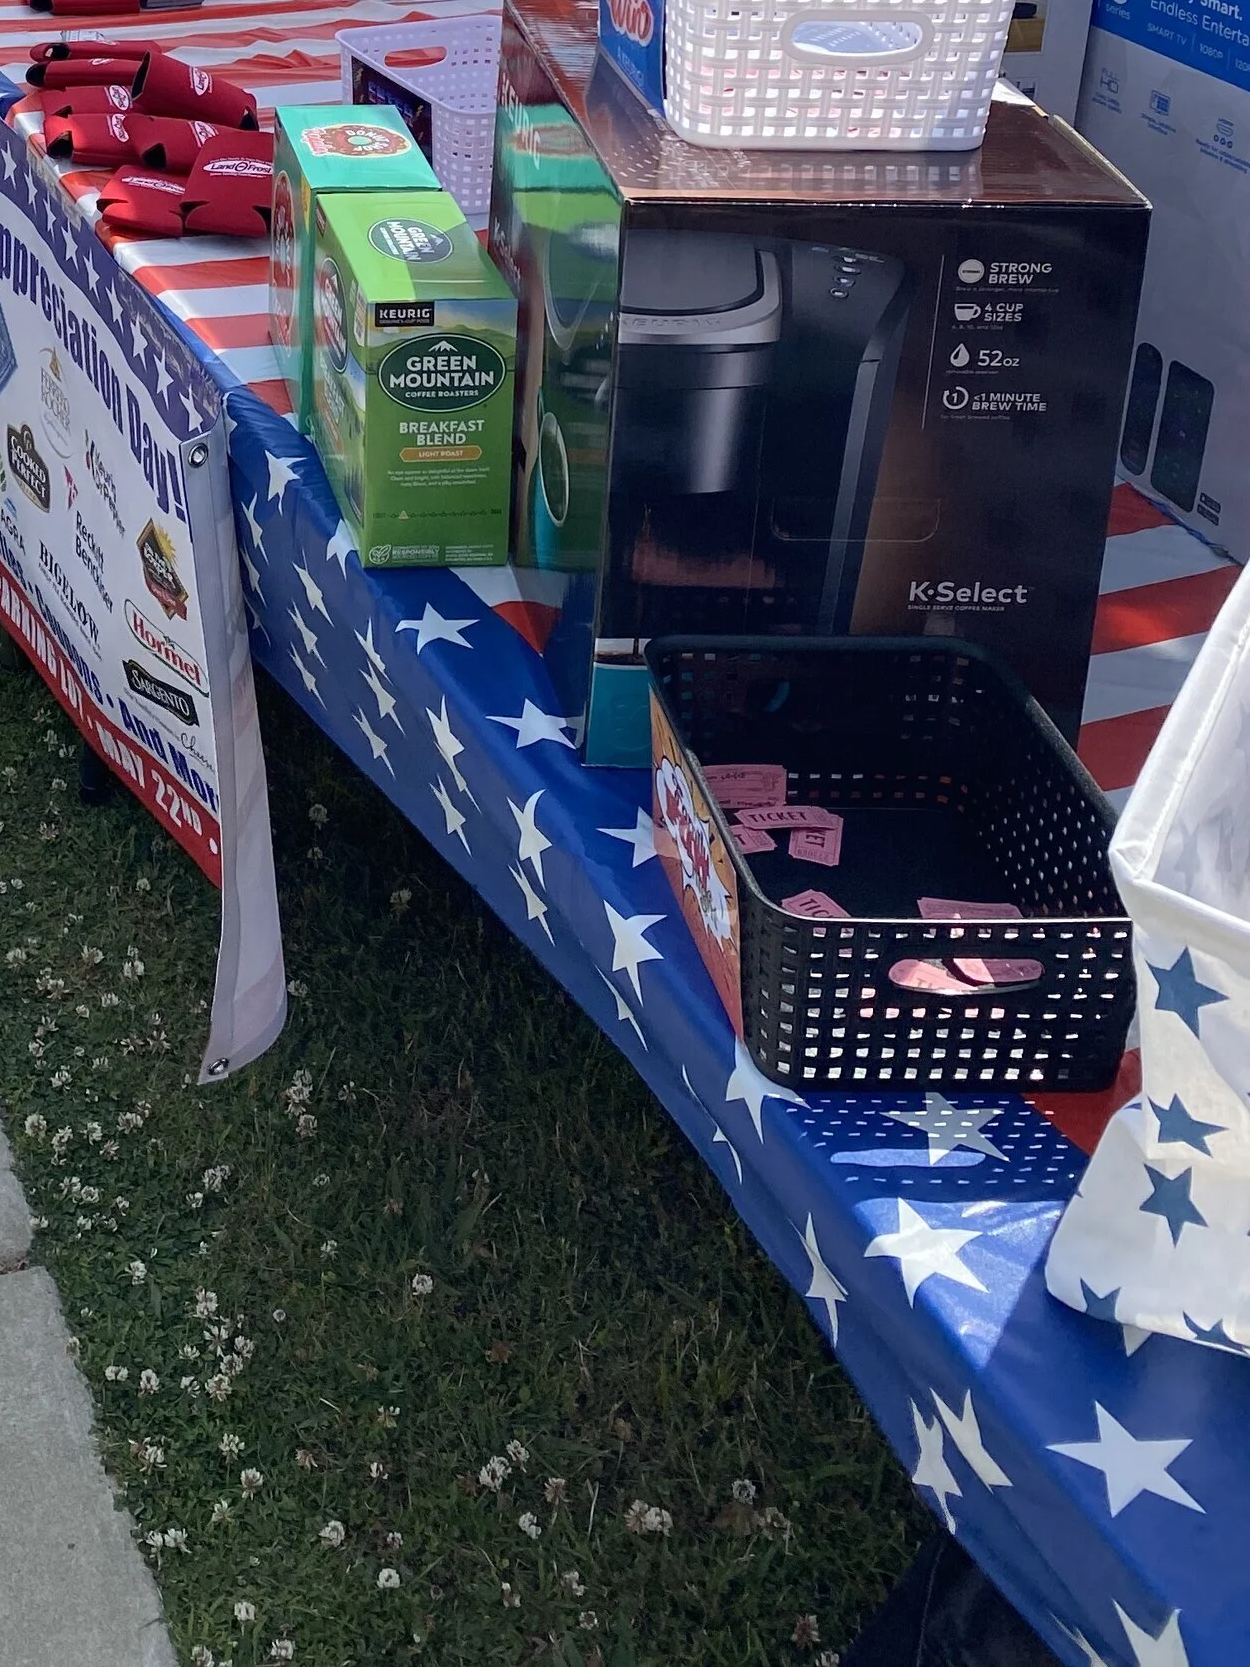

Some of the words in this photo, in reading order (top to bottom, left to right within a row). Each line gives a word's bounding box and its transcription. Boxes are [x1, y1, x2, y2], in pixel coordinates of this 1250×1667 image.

[1105, 3, 1131, 21] series
[1146, 22, 1175, 40] SMART
[1176, 35, 1187, 45] TV
[386, 221, 421, 261] MOUNTAIN
[407, 226, 435, 253] GREEN
[989, 263, 1053, 273] STRONG
[988, 274, 1034, 284] BREW
[379, 309, 432, 319] KEURIG
[984, 303, 992, 312] 4
[995, 303, 1024, 312] CUP
[984, 313, 1022, 322] SIZES
[406, 355, 476, 371] GREEN
[978, 350, 1020, 367] 52oz
[389, 371, 495, 388] MOUNTAIN
[989, 393, 1041, 402] MINUTE
[972, 402, 1012, 411] BREW
[1015, 403, 1047, 411] TIME
[400, 420, 485, 434] BREAKFAST
[416, 433, 466, 446] BLEND
[10, 434, 47, 483] COOKED
[126, 383, 187, 524] Day!
[10, 450, 47, 499] PERFECT
[38, 539, 100, 645] BIGELOW
[131, 611, 201, 686] Hormel
[131, 669, 190, 717] SARGENTO
[117, 697, 169, 765] And
[59, 656, 84, 722] LOT
[95, 720, 145, 790] MAY
[151, 769, 203, 836] 22ND
[748, 811, 808, 823] TICKET
